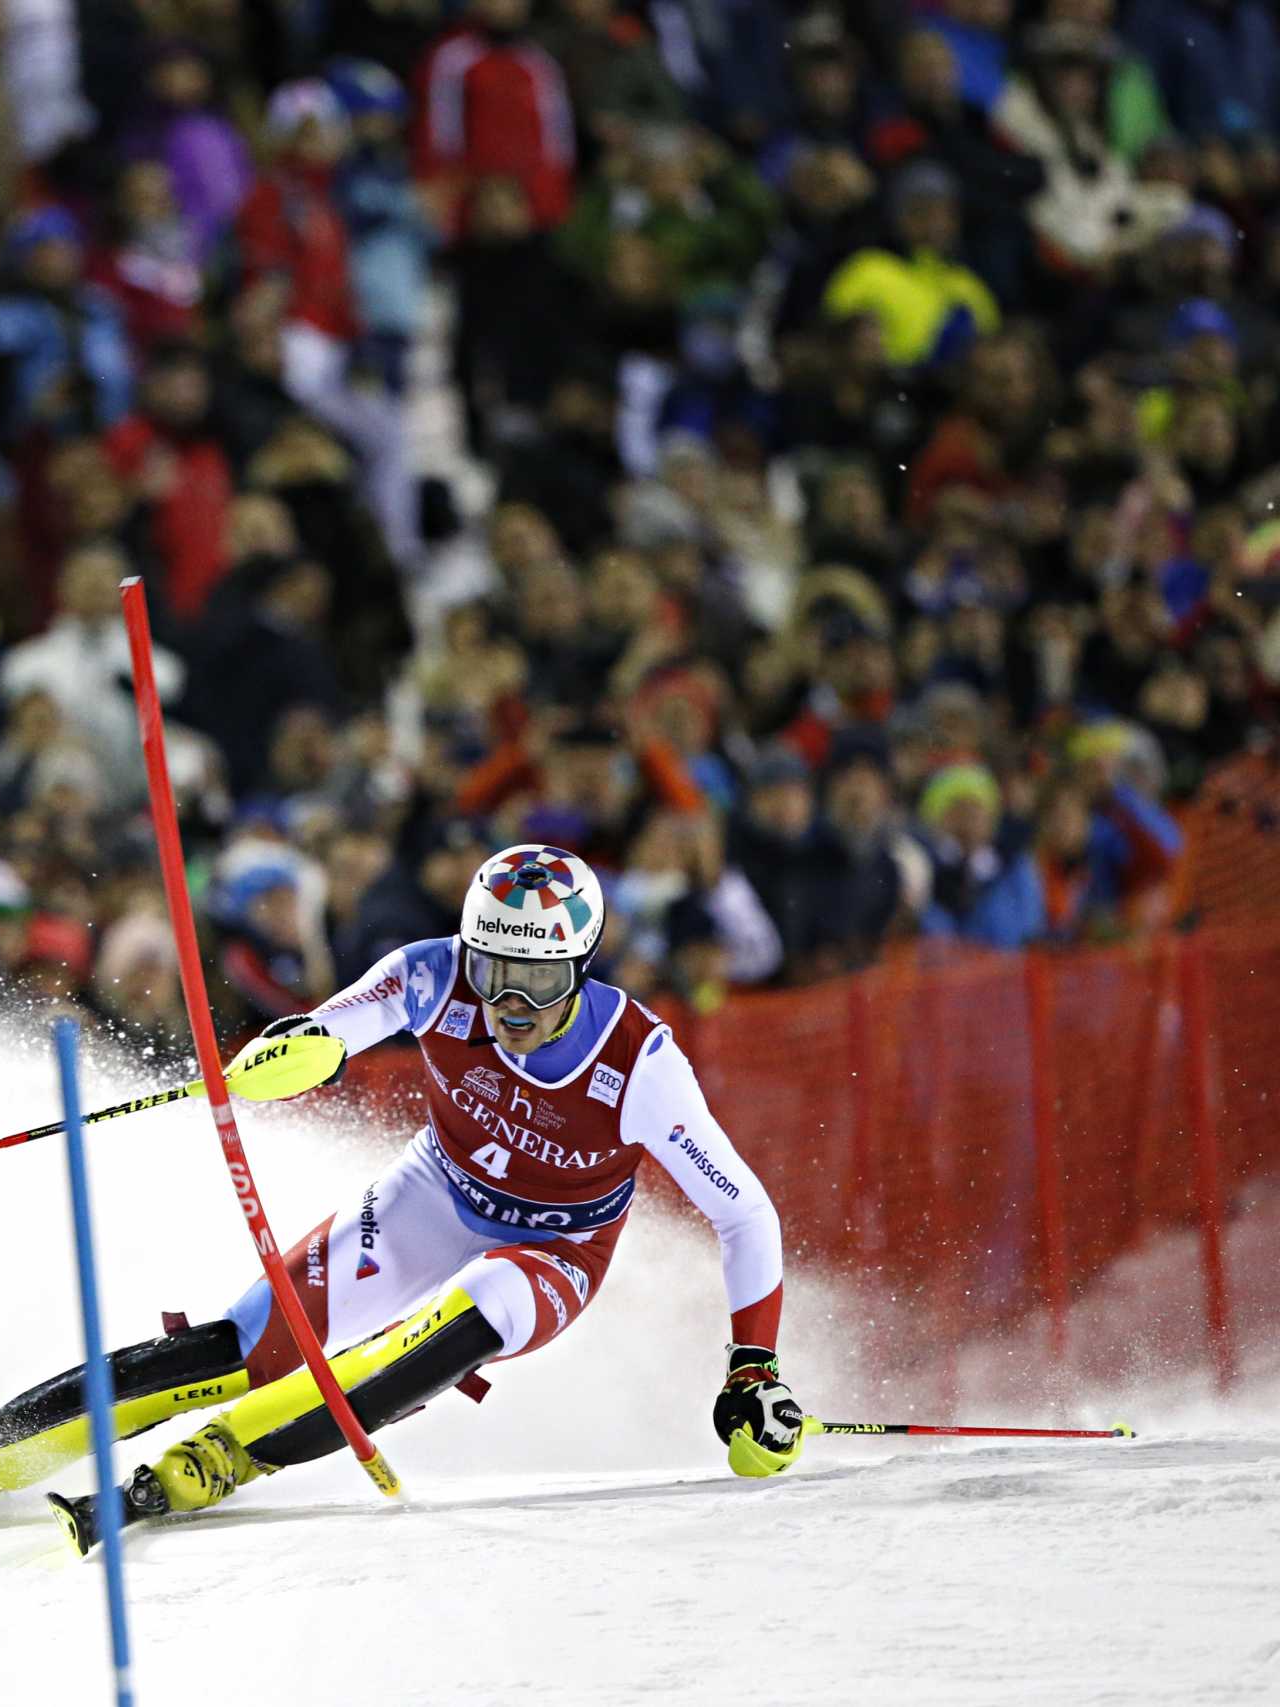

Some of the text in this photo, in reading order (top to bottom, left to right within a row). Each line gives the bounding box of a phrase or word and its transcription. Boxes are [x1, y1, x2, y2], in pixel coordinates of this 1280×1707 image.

[476, 914, 546, 939] helvetia
[243, 1043, 288, 1072] LEKI
[129, 1086, 185, 1113] LEKI
[470, 1141, 512, 1180] 4
[680, 1138, 740, 1200] swisscom
[402, 1309, 442, 1348] LEKI
[173, 1384, 223, 1402] LEKI
